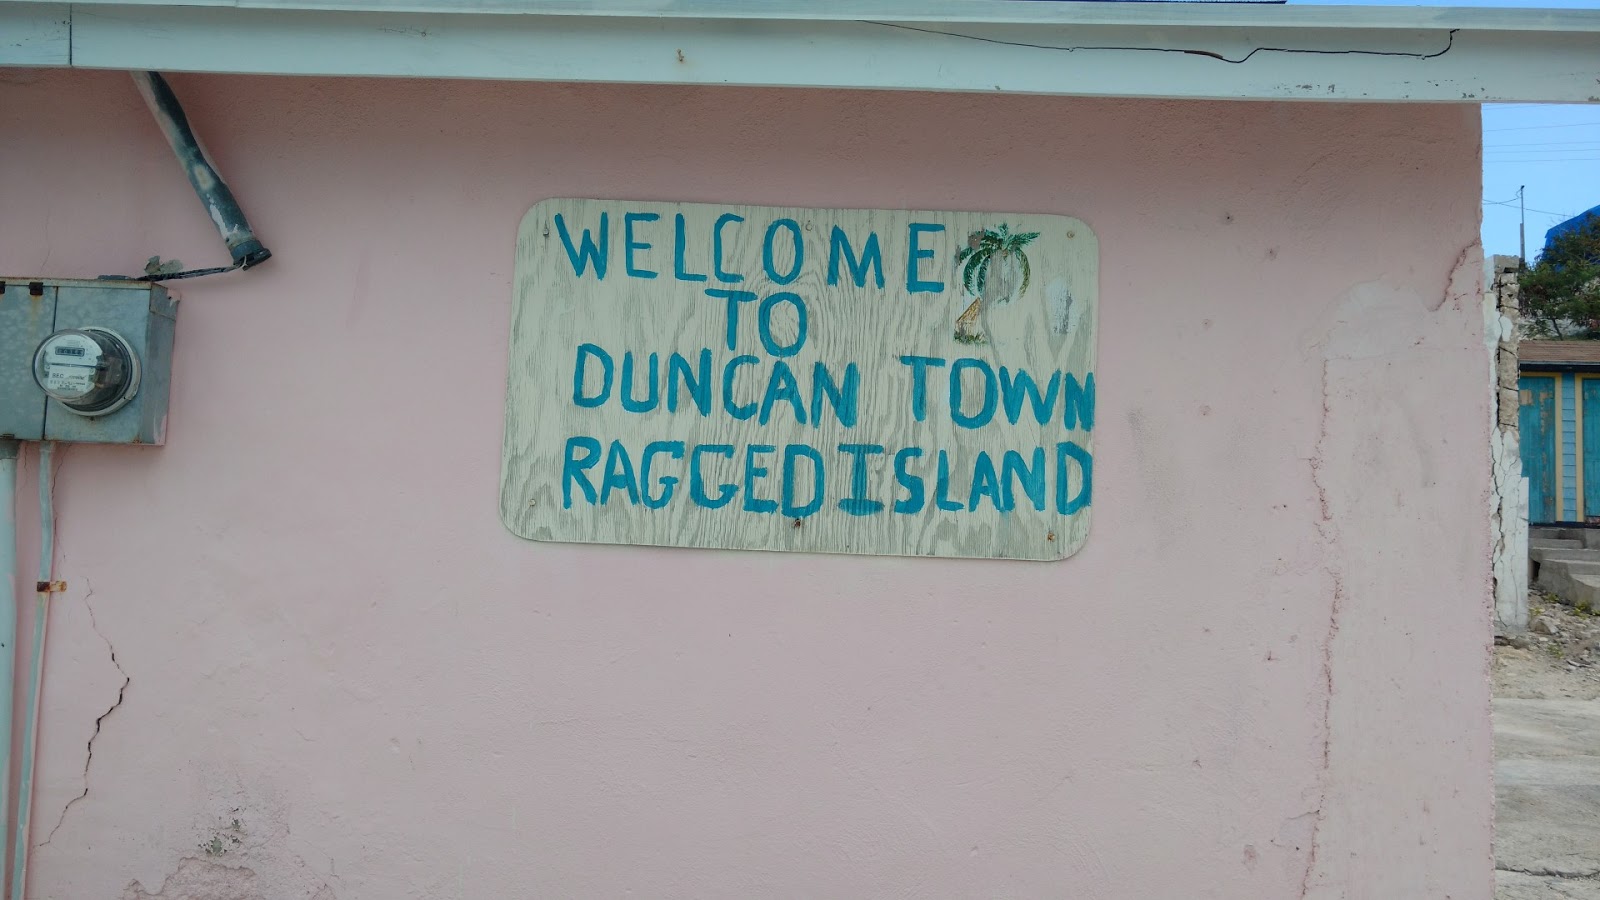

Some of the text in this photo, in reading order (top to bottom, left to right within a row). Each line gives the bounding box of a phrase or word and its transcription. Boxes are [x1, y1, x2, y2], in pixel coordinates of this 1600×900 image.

[554, 211, 946, 294] WELCOME
[704, 288, 808, 358] TO
[572, 343, 1096, 432] DUNCAN TOWN
[561, 436, 1093, 519] RAGGED ISLAND
